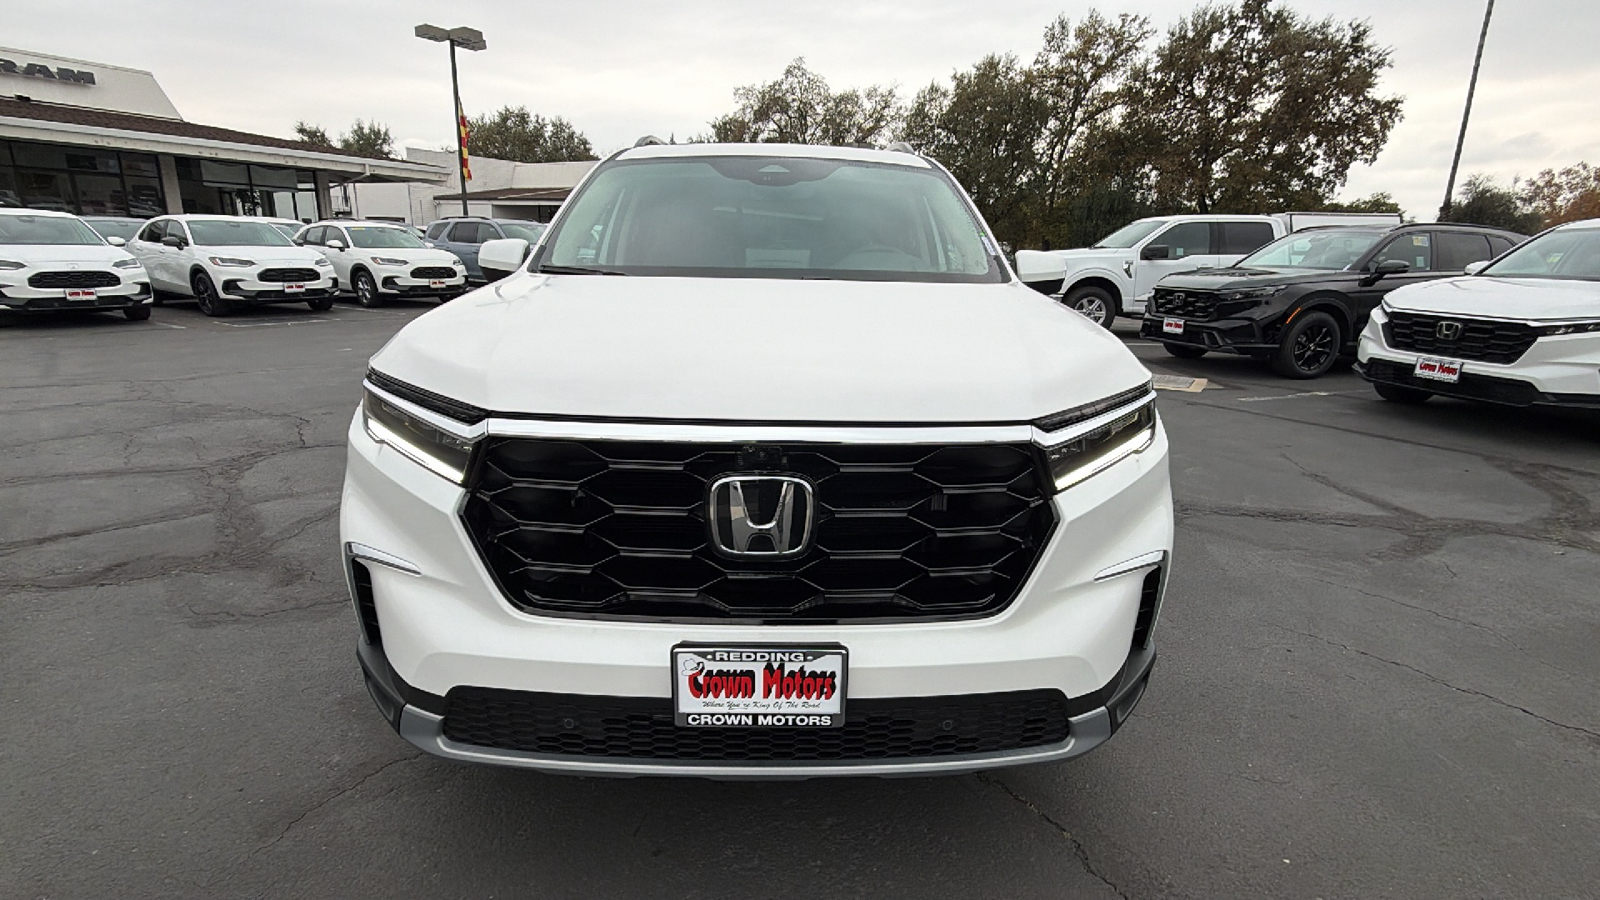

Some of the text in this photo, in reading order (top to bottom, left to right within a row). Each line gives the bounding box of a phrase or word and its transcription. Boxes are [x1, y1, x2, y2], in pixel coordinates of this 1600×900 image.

[715, 651, 804, 662] REDDING
[688, 662, 837, 700] Crown Motors
[752, 701, 771, 709] King
[772, 701, 783, 709] Of
[687, 714, 832, 726] CROWN MOTORS
